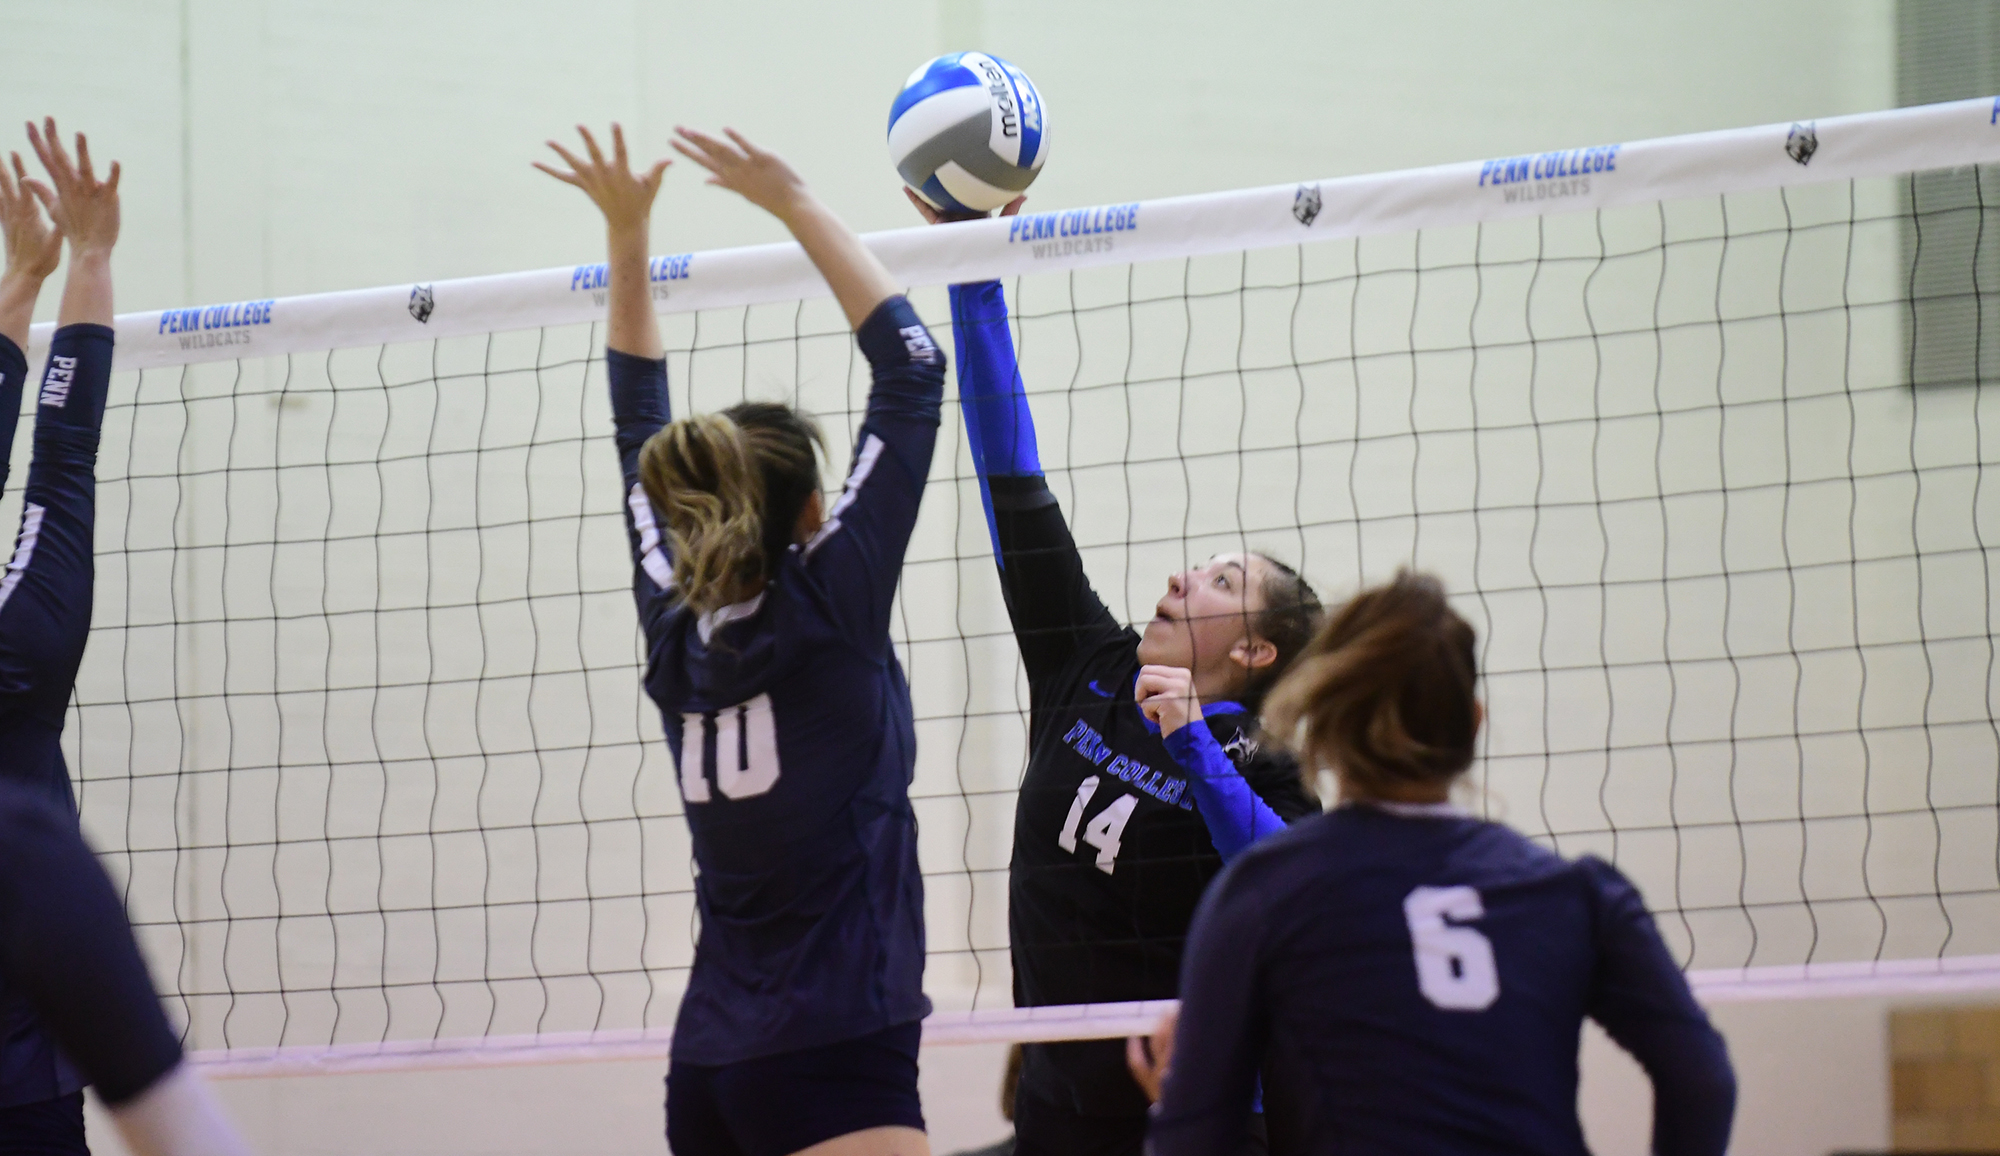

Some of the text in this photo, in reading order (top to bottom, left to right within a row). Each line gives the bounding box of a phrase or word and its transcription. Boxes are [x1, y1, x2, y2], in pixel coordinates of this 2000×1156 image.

[979, 61, 1018, 137] molten
[1478, 144, 1620, 187] PENN COLLEGE
[1504, 178, 1590, 202] WILDCATS
[1009, 203, 1139, 243] PENN COLLEGE
[1033, 236, 1114, 259] WILDCATS
[159, 300, 275, 334] PENN COLLEGE
[178, 330, 251, 350] WILDCATS
[40, 355, 77, 408] PENN
[679, 692, 781, 803] 10
[1062, 718, 1113, 766] PENN
[1058, 774, 1139, 875] 14
[1403, 884, 1500, 1012] 6
